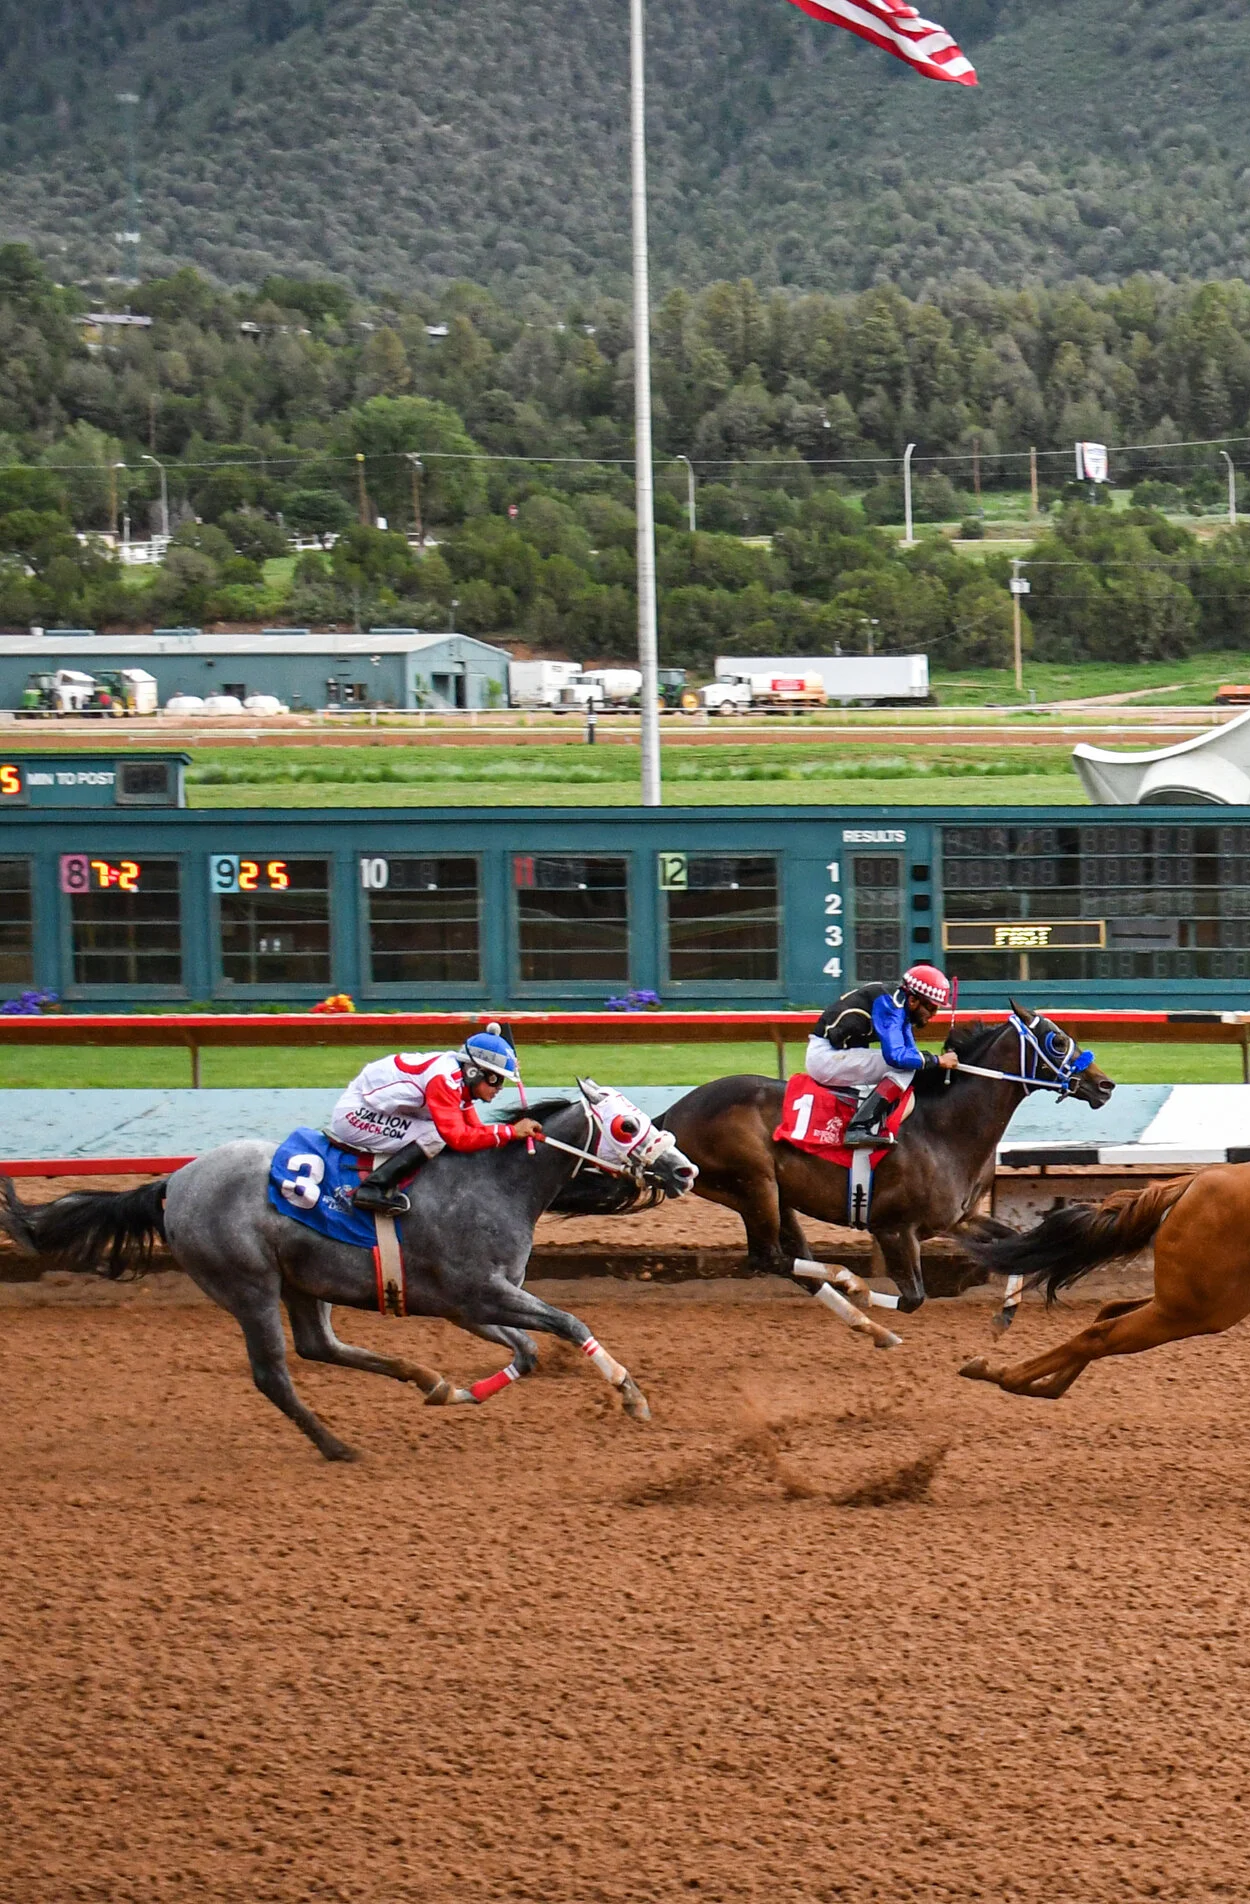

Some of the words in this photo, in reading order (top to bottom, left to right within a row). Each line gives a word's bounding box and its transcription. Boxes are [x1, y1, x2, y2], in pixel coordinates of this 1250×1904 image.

[26, 772, 54, 785] MIN
[55, 772, 77, 785] TO
[77, 771, 116, 785] POST
[842, 830, 906, 842] RESULTS
[67, 859, 85, 888] 8
[216, 858, 235, 888] 9
[361, 858, 388, 888] 10
[513, 857, 534, 886] 11
[658, 856, 686, 886] 12
[826, 862, 840, 882] 1
[824, 894, 843, 915] 2
[825, 925, 843, 947] 3
[823, 957, 843, 978] 4
[355, 1107, 412, 1130] STALLION
[790, 1094, 814, 1140] 1
[281, 1153, 325, 1210] 3
